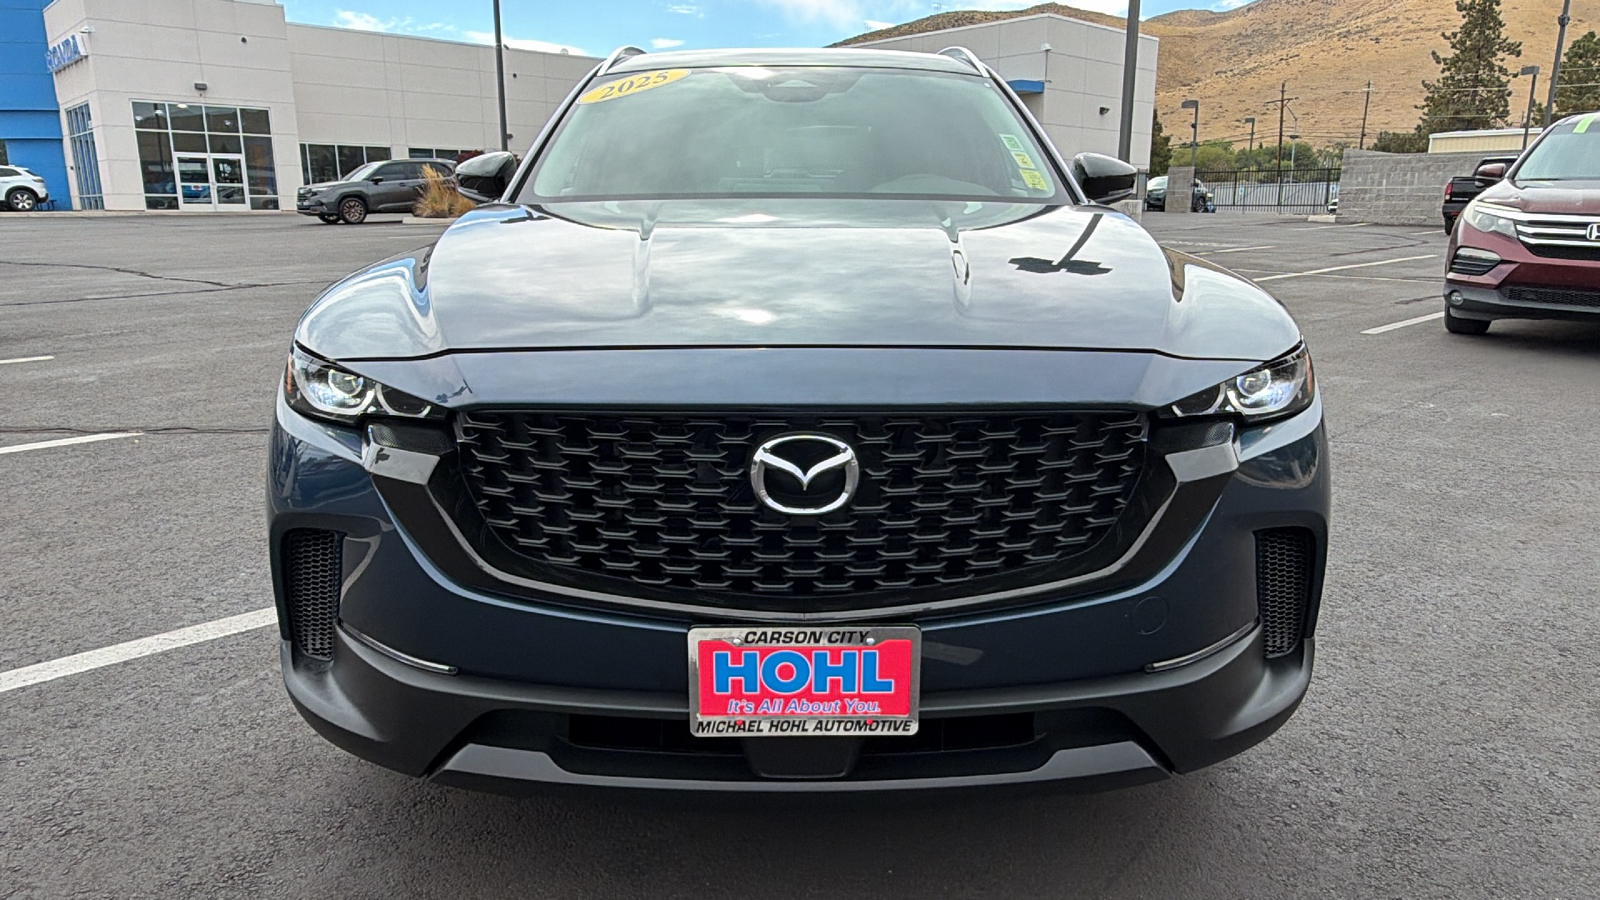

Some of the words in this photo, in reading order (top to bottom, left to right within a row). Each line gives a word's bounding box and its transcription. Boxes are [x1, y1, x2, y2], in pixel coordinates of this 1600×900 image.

[600, 71, 669, 99] 2025
[744, 631, 822, 645] CARSON
[827, 631, 869, 645] CITY
[713, 650, 894, 694] HOHL
[727, 698, 754, 713] It's
[757, 698, 782, 713] All
[785, 698, 840, 713] About
[845, 698, 881, 713] You.
[696, 720, 763, 733] MICHAEL
[768, 720, 809, 733] HOHL
[812, 719, 913, 732] AUTOMOTIVE
